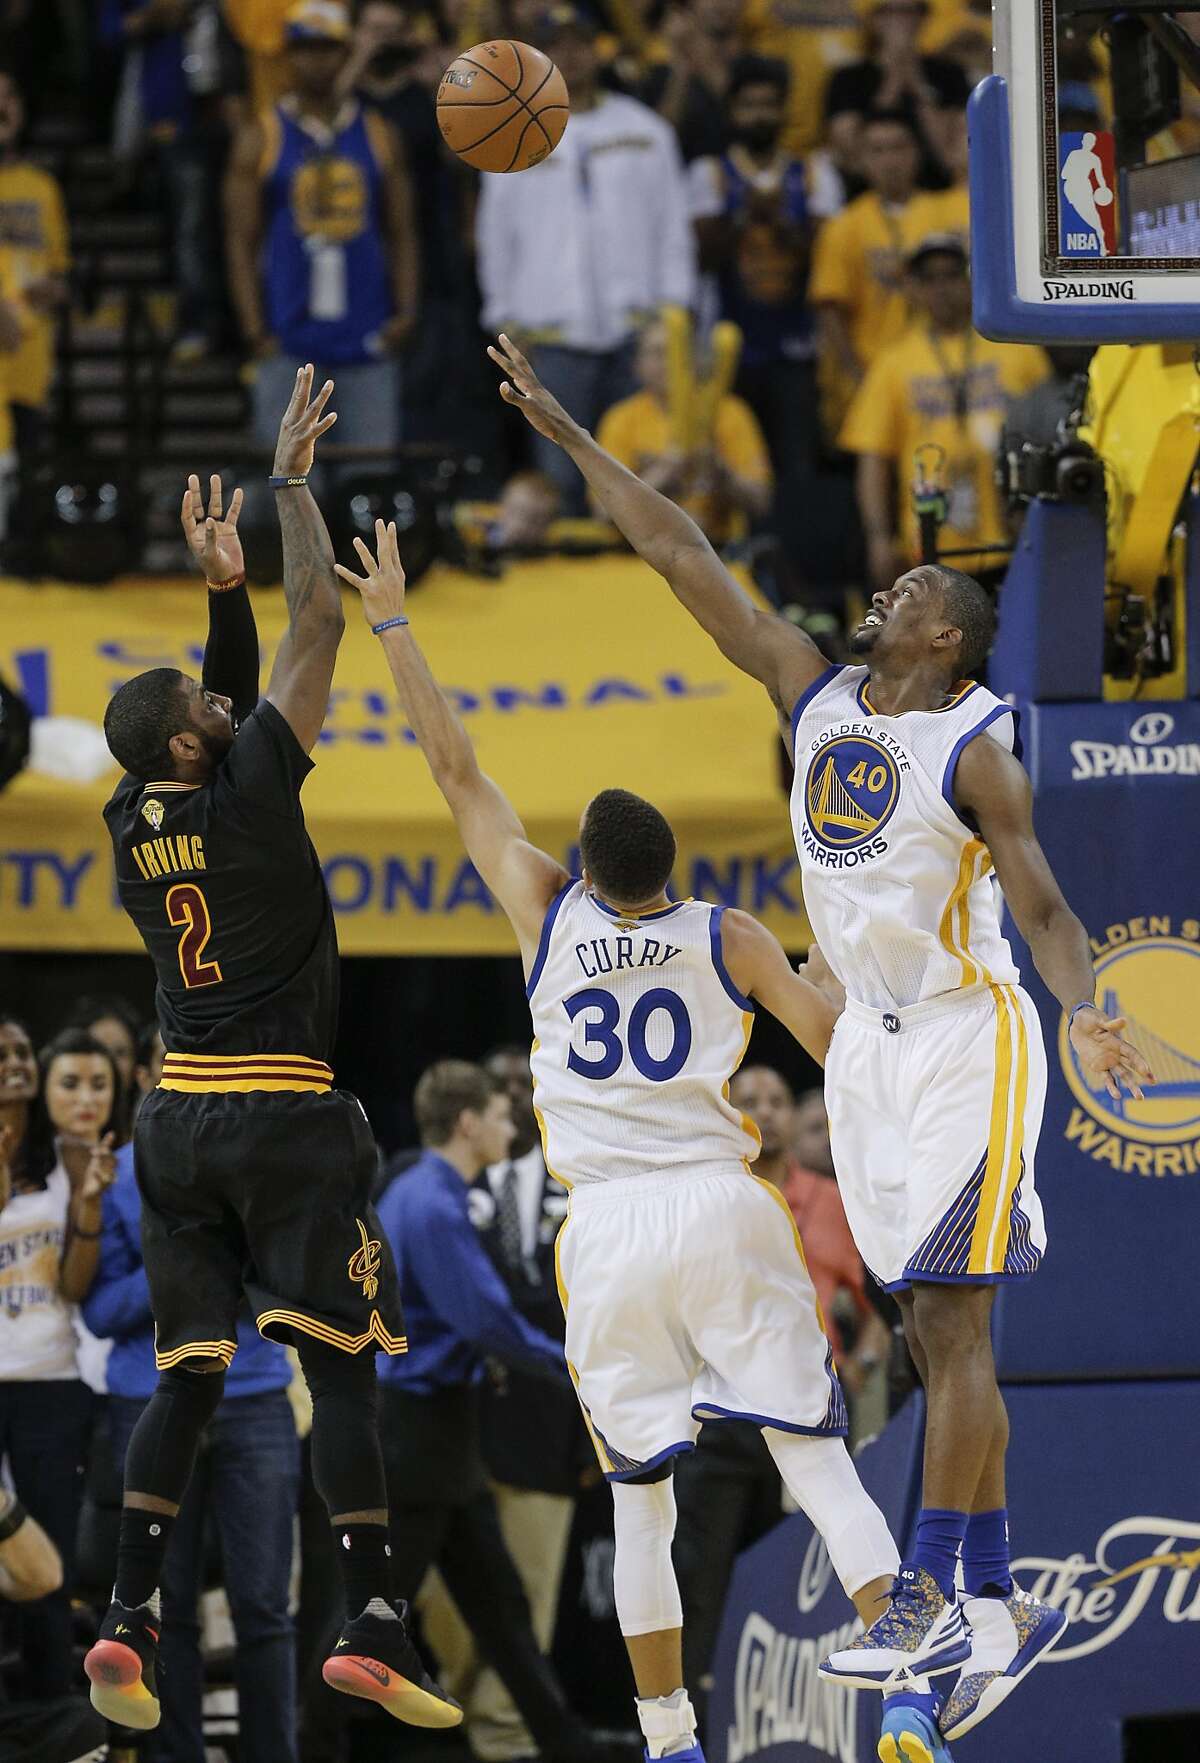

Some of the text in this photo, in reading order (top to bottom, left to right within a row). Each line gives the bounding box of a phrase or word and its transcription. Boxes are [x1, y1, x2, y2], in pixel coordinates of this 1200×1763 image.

[1067, 233, 1098, 250] NBA
[1043, 280, 1134, 301] SPALDING
[811, 724, 911, 773] GOLDEN STATE
[846, 760, 888, 793] 40
[131, 835, 207, 881] IRVING
[801, 822, 889, 869] WARRIORS
[165, 883, 223, 989] 2
[575, 936, 682, 978] CURRY
[1088, 915, 1170, 958] LDEN
[562, 987, 692, 1082] 30
[1064, 1106, 1200, 1178] WARRI
[902, 1570, 915, 1580] 40
